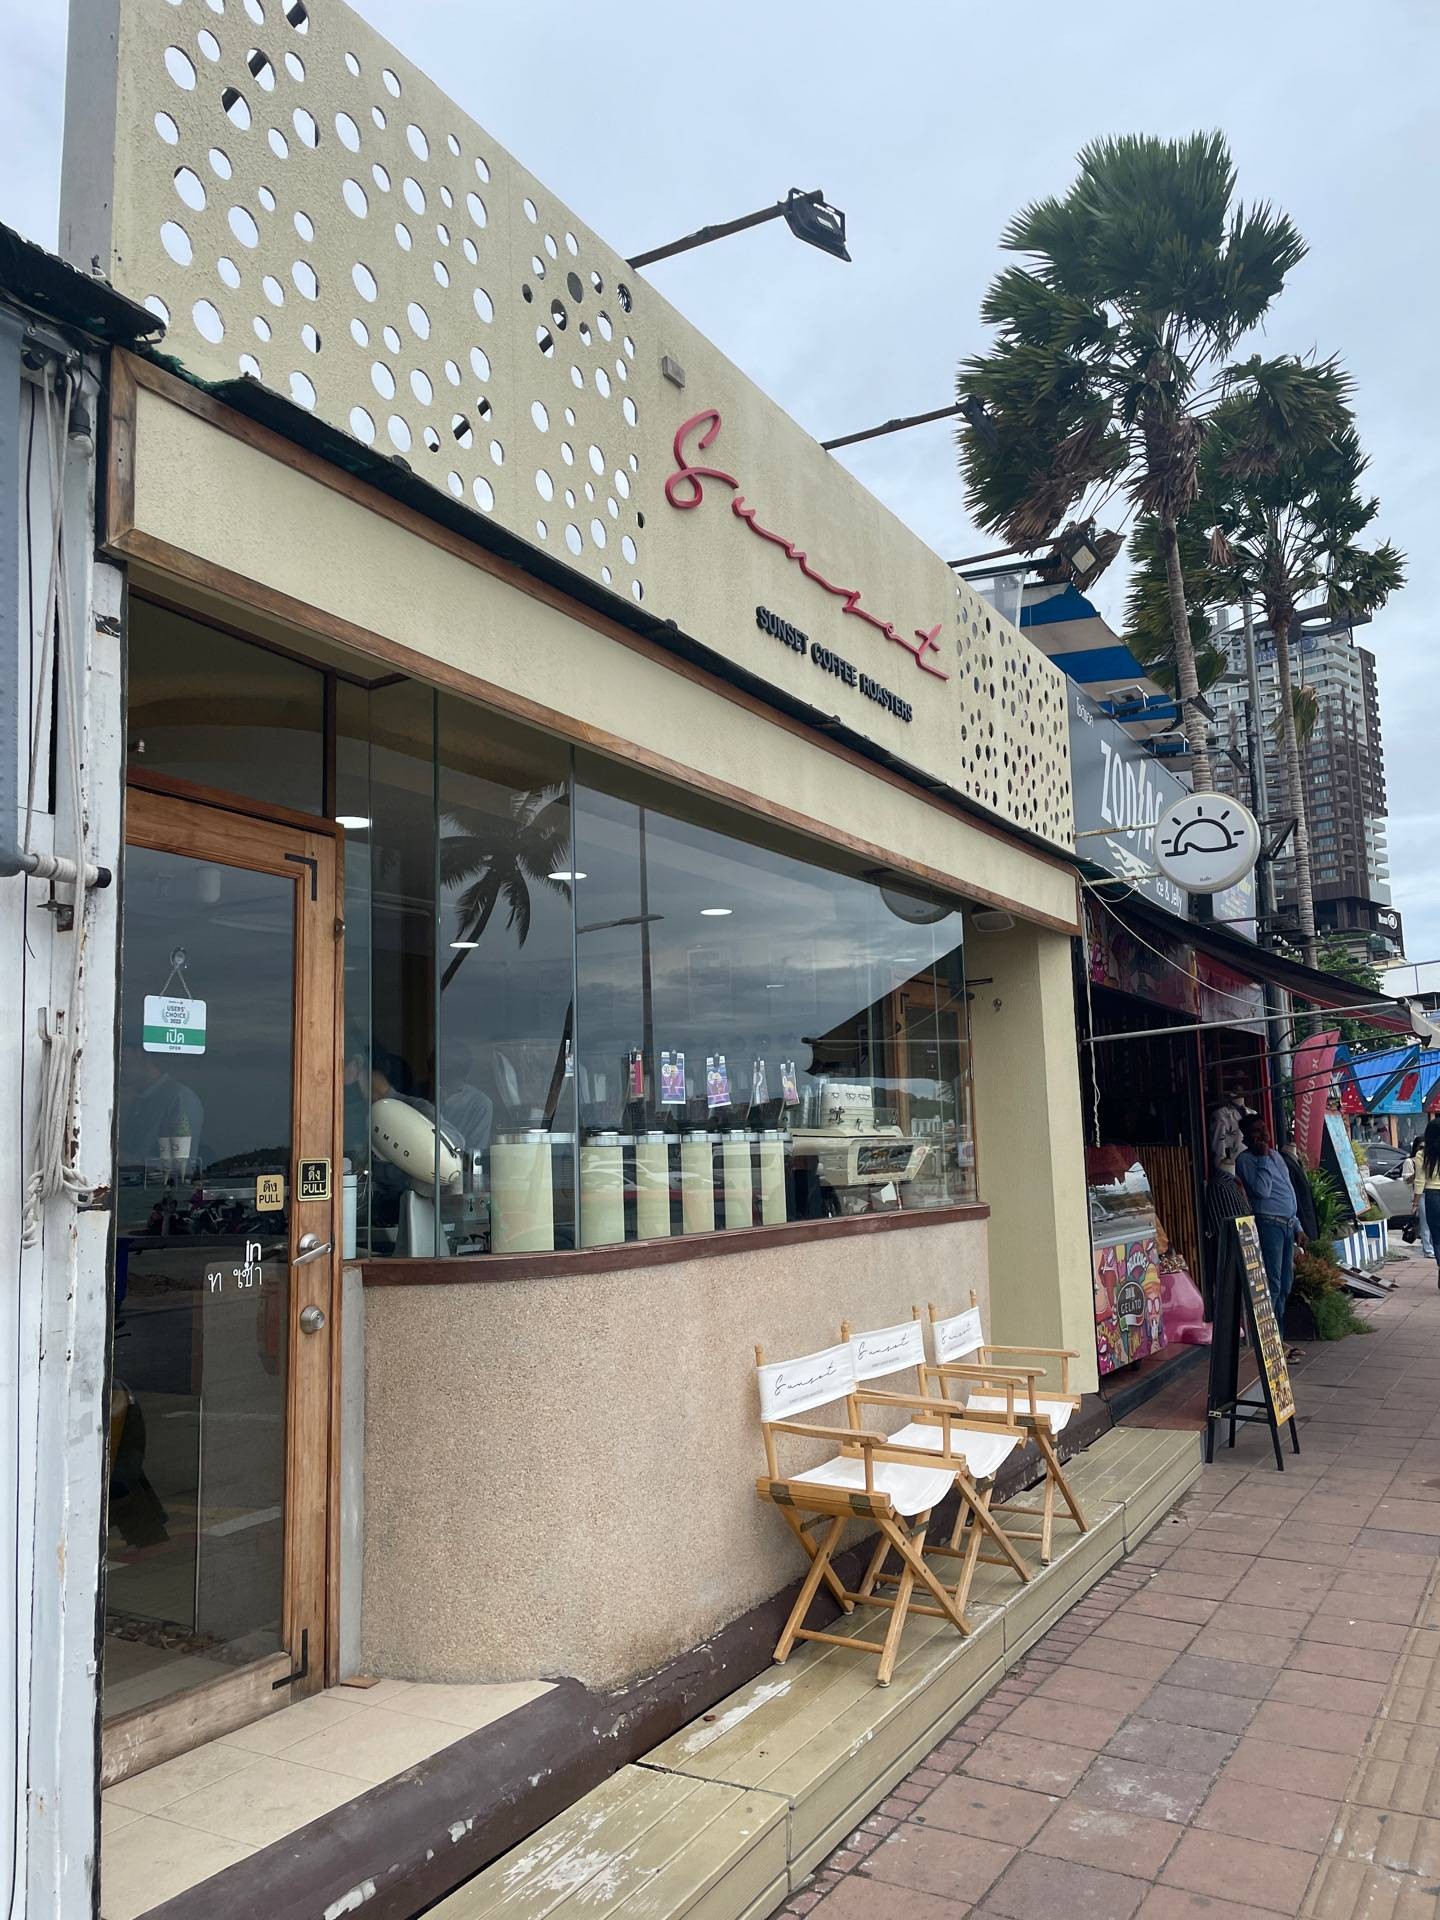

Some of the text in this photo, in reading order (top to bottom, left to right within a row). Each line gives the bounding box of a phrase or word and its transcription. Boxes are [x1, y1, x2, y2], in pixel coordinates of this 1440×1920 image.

[664, 408, 949, 681] Sunset
[756, 606, 913, 723] SUNSET COFFEE ROASTERS
[165, 1011, 186, 1019] CHOICE
[308, 1165, 321, 1180] ดึง
[303, 1183, 326, 1194] PULL
[259, 1194, 281, 1204] PULL
